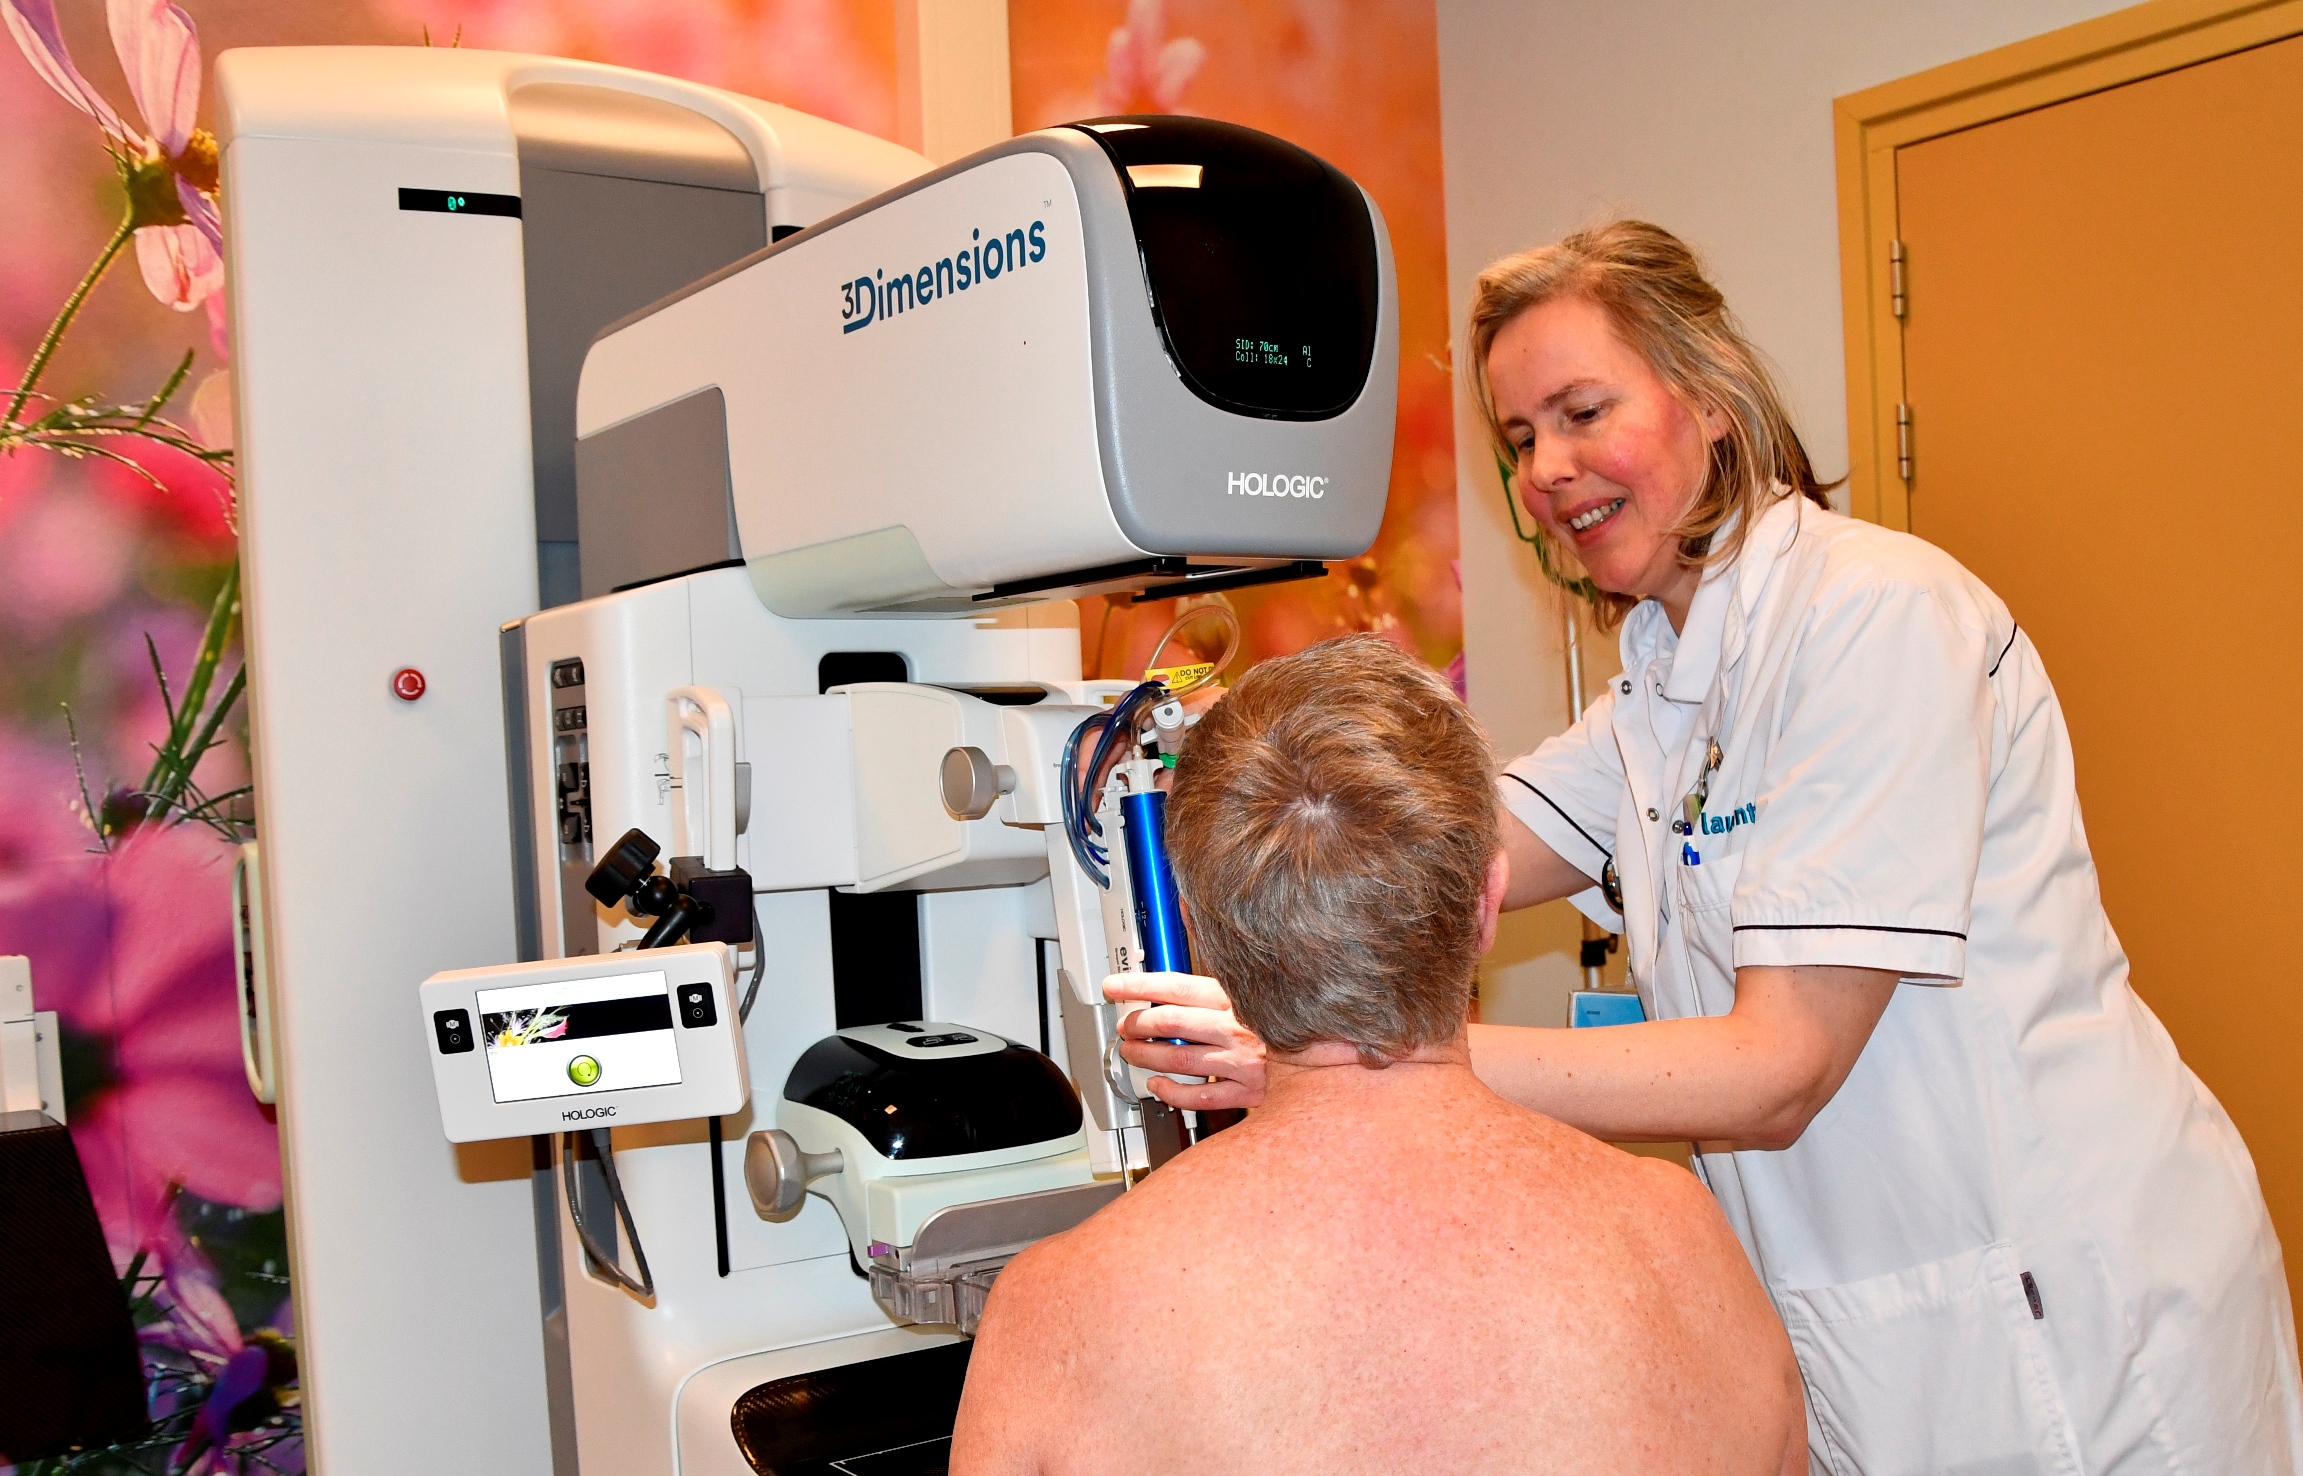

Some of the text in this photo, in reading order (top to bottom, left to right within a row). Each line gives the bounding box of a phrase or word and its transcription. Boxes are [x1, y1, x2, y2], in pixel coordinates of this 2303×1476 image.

[841, 220, 1047, 335] 3Dimensions
[1235, 338, 1254, 350] SID:
[1259, 340, 1279, 353] 70cm
[1235, 350, 1312, 368] Coll: 18x24 C
[1180, 669, 1191, 677] DO
[1193, 667, 1207, 675] NOT
